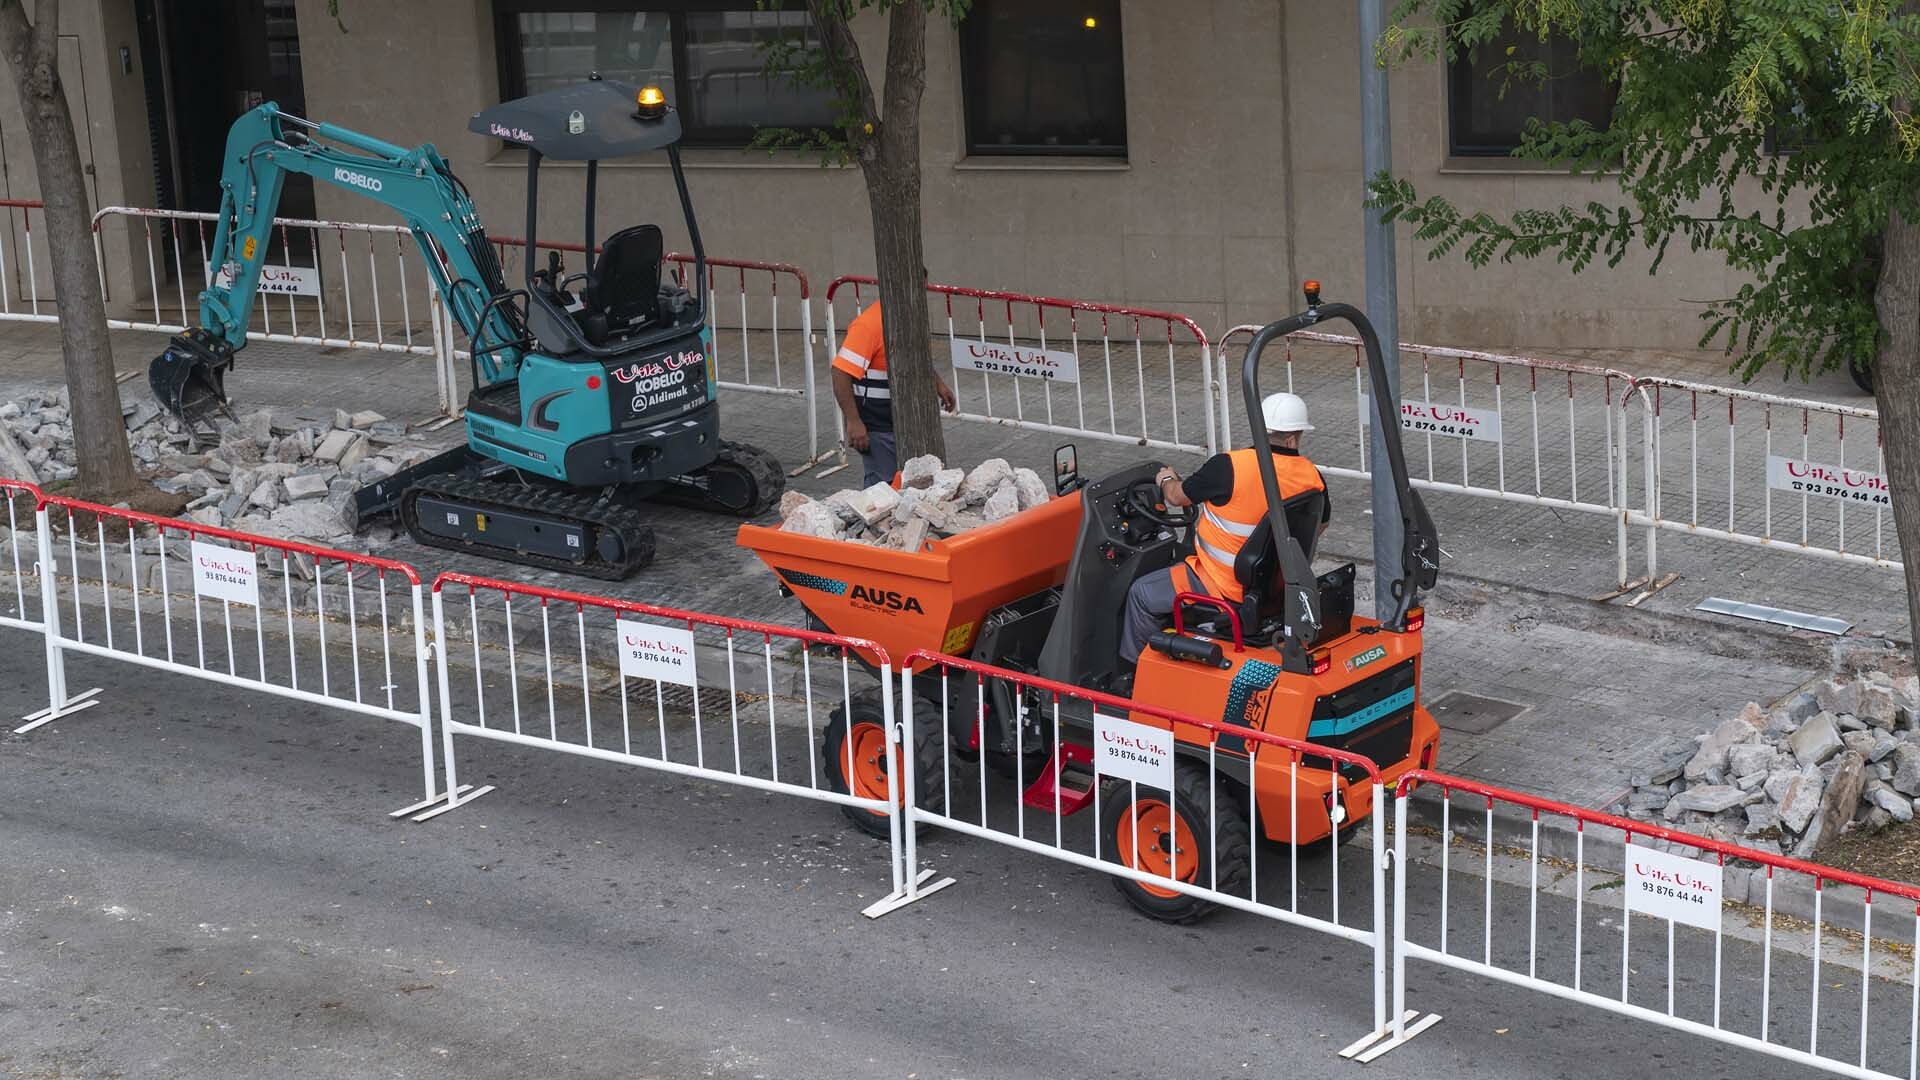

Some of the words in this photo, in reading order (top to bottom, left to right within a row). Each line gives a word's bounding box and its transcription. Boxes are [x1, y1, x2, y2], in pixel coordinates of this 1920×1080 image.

[334, 167, 383, 192] KOBELCO
[986, 362, 998, 371] 93
[1002, 365, 1021, 374] 876
[1024, 368, 1037, 377] 44
[1041, 369, 1054, 378] 44
[635, 370, 684, 394] KOBELCO
[648, 386, 688, 406] Aldimak
[1415, 422, 1436, 431] 876
[1440, 425, 1455, 434] 44
[1458, 427, 1473, 436] 44
[1806, 483, 1821, 493] 93
[1826, 486, 1848, 498] 876
[1852, 492, 1868, 501] 44
[1873, 495, 1889, 504] 44
[215, 573, 227, 582] 876
[238, 578, 246, 586] 44
[850, 584, 924, 615] AUSA
[632, 651, 642, 659] 93
[644, 652, 659, 662] 876
[660, 656, 670, 664] 44
[672, 658, 681, 666] 44
[1355, 647, 1385, 666] AUSA
[1351, 692, 1408, 723] ELECTRIC
[1108, 747, 1119, 757] 93
[1121, 751, 1136, 761] 876
[1138, 754, 1147, 764] 44
[1149, 758, 1159, 767] 44
[1642, 882, 1654, 892] 93
[1657, 885, 1674, 897] 876
[1676, 891, 1688, 901] 44
[1691, 894, 1703, 905] 44
